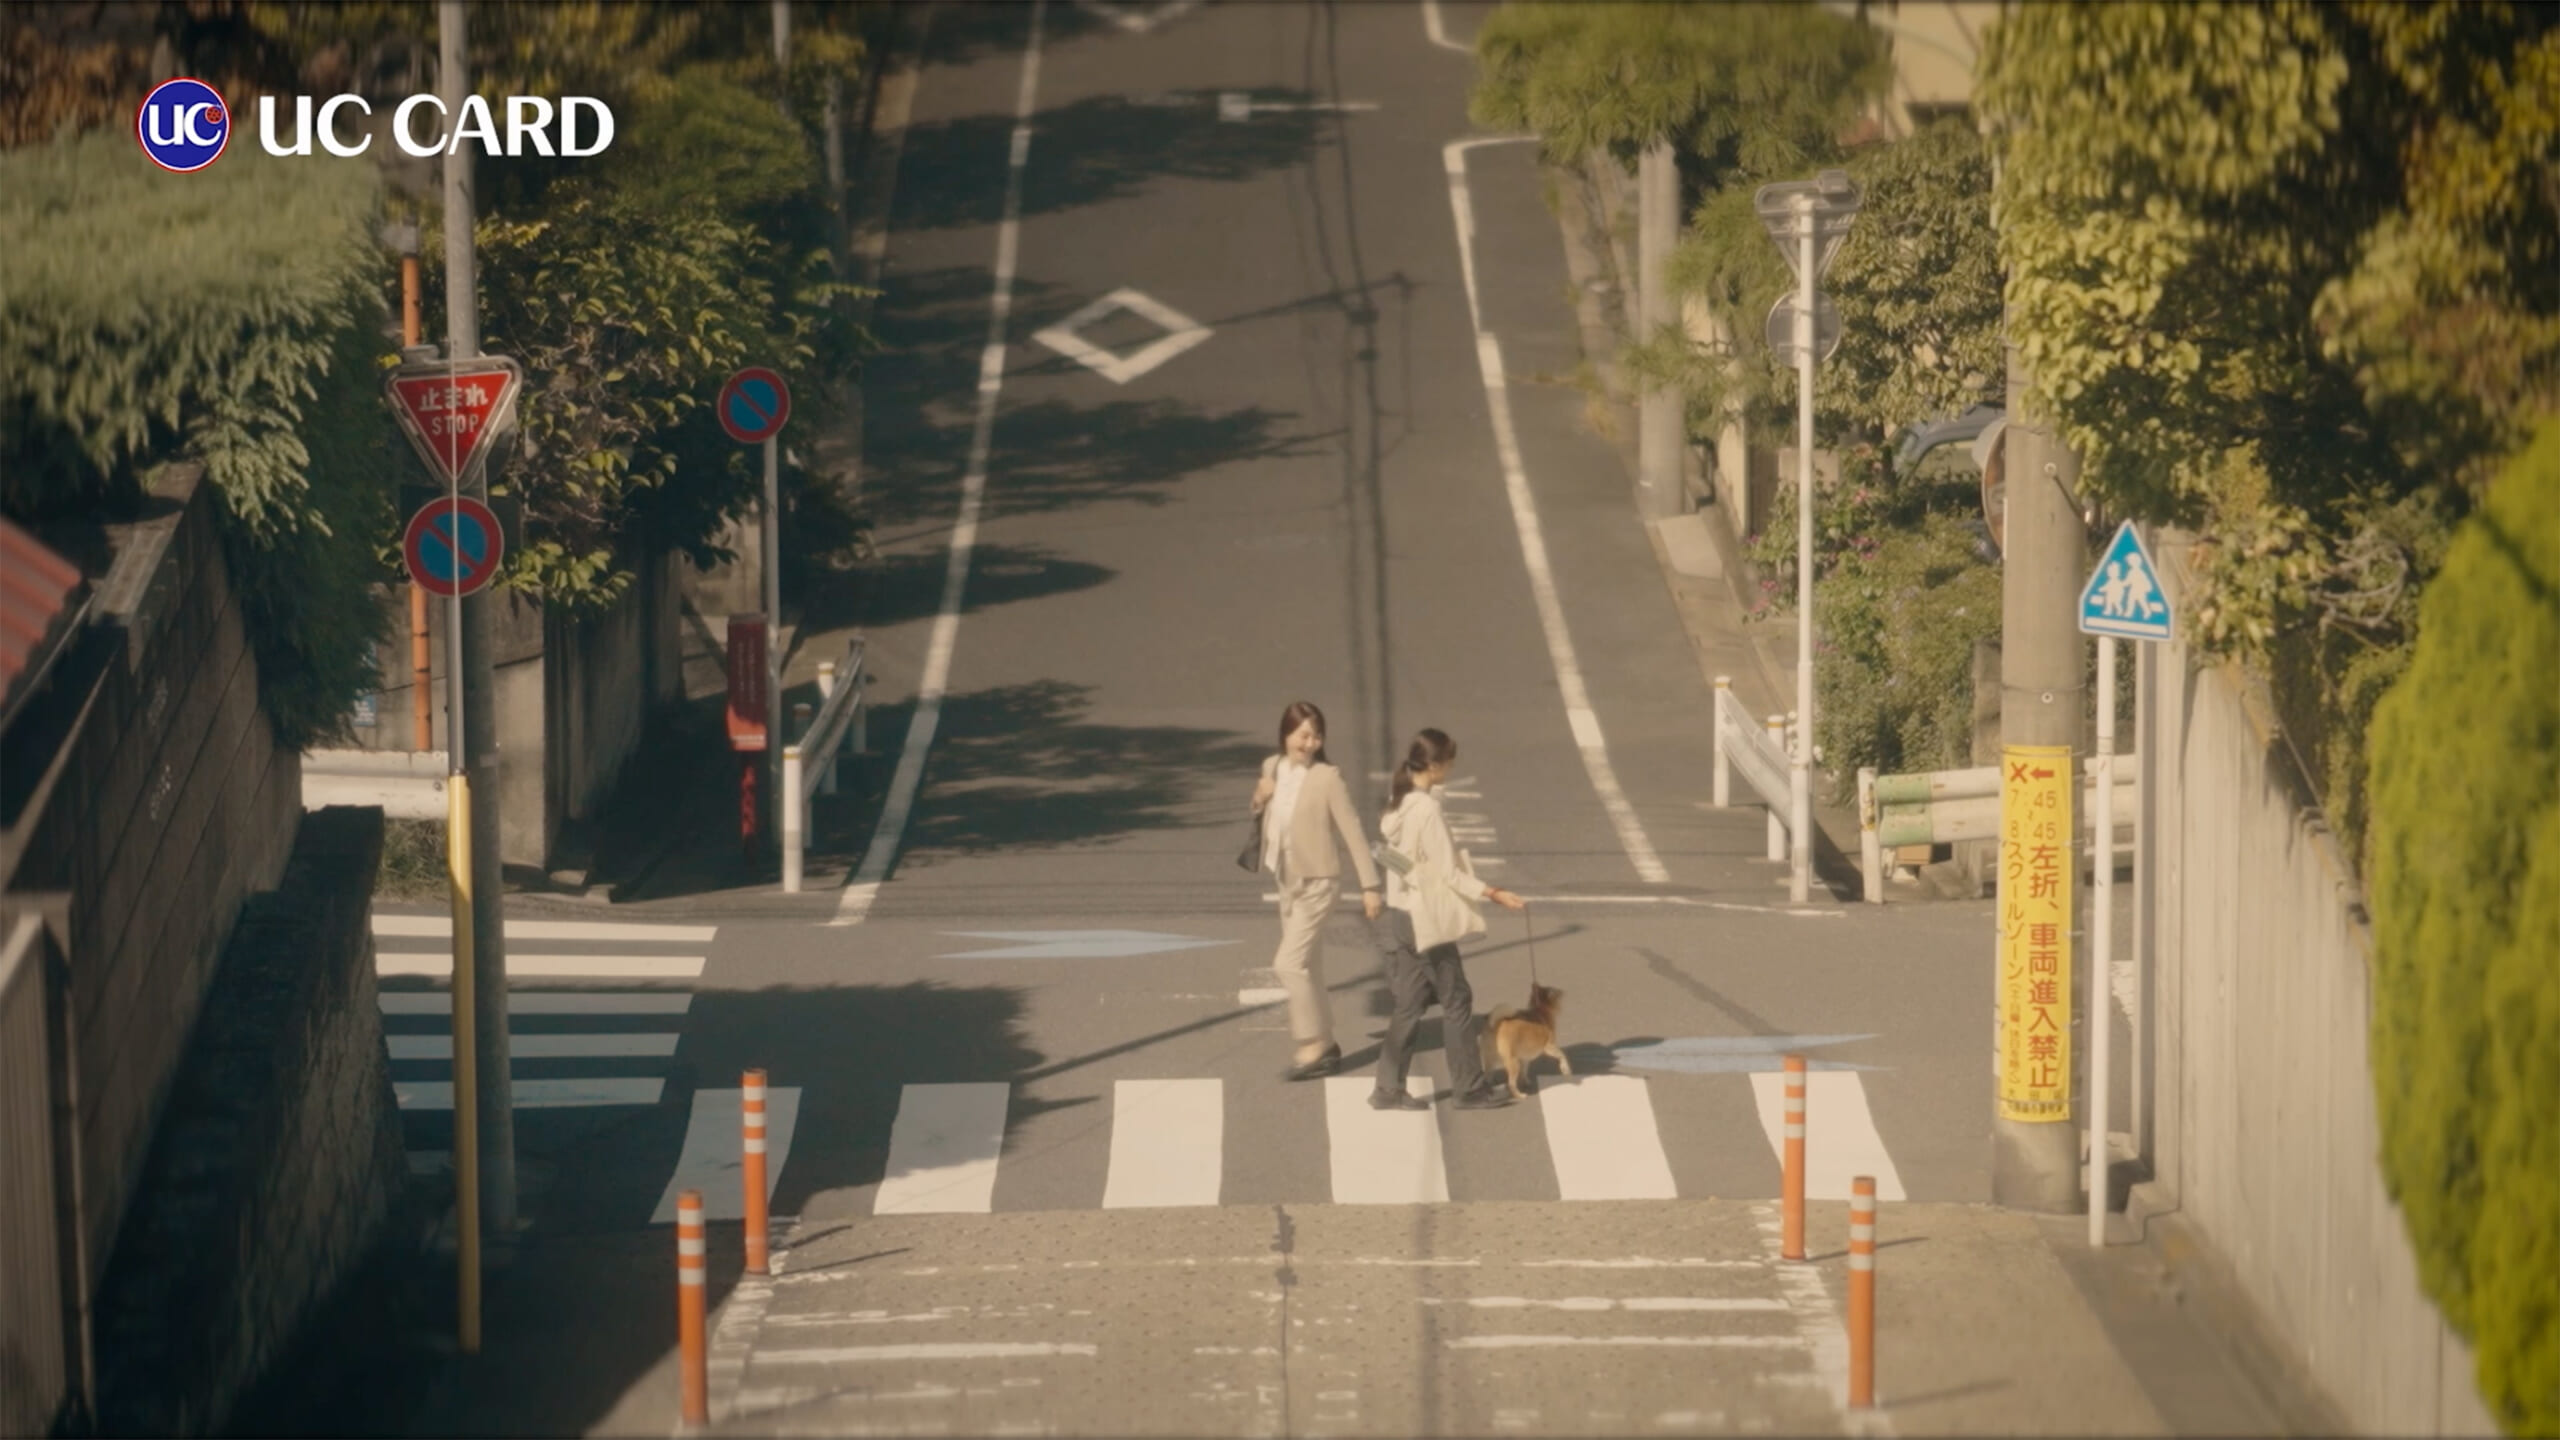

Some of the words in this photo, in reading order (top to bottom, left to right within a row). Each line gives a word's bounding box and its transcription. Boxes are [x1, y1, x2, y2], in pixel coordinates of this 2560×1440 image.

[419, 383, 489, 412] 止まれ
[431, 414, 480, 436] STOP
[2028, 844, 2060, 1089] 左折、車両進入禁止
